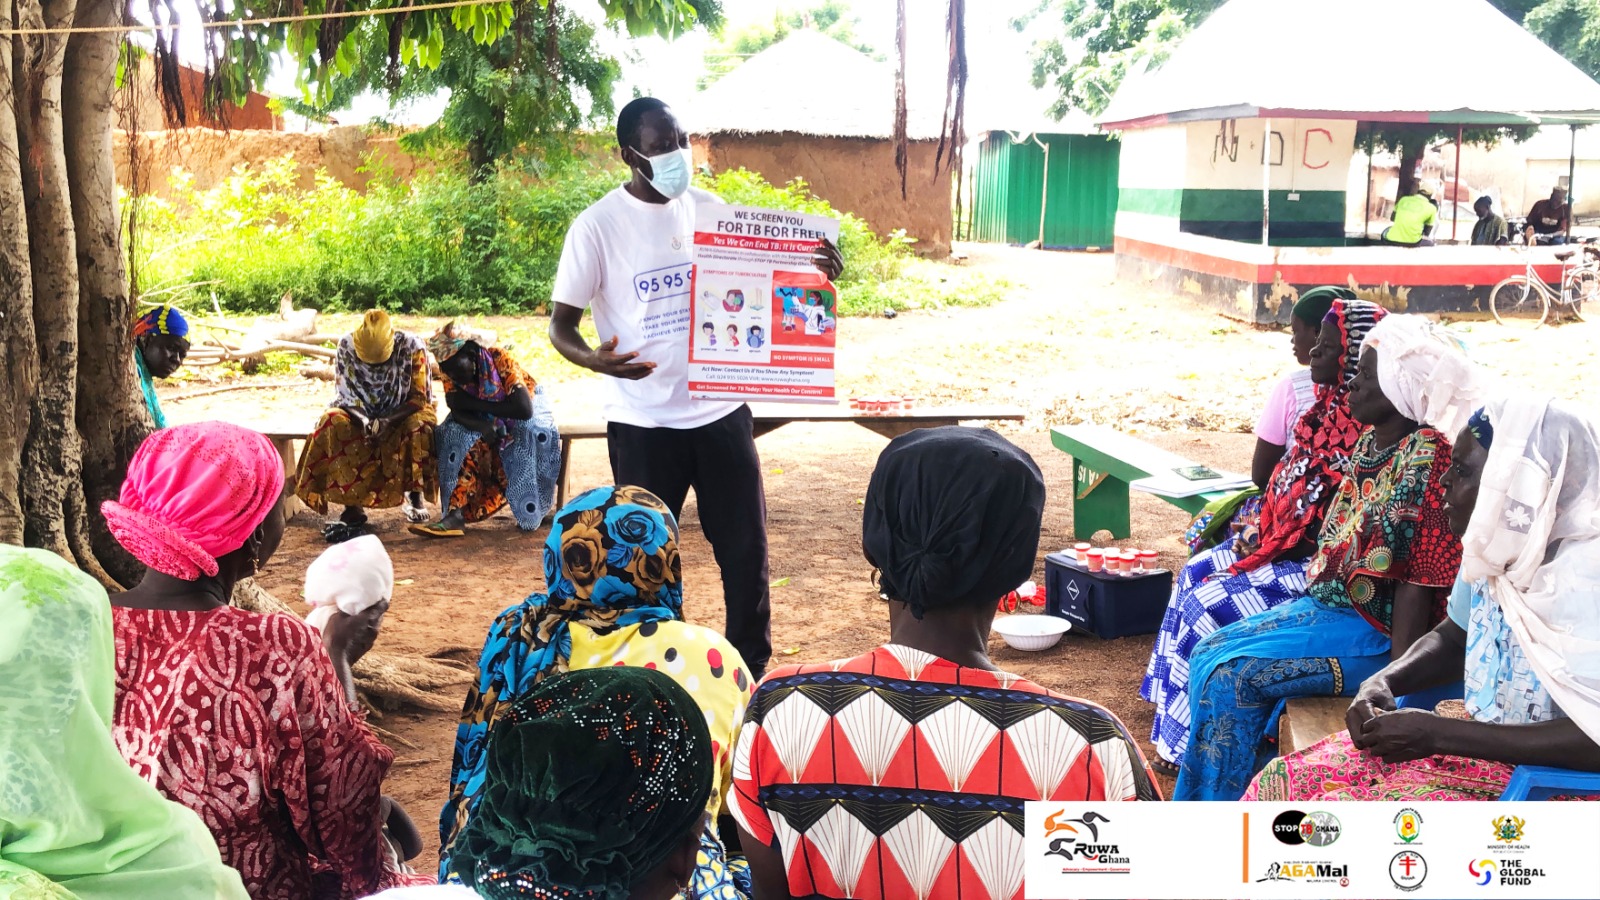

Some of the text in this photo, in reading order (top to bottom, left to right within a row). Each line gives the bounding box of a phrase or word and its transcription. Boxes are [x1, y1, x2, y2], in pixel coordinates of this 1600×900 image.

[734, 210, 803, 227] WE SCREEN YOU
[717, 220, 826, 240] FOR TB FOR FREE!
[713, 236, 726, 246] Yes
[727, 236, 739, 247] We
[739, 238, 754, 248] Can
[755, 240, 769, 251] End
[770, 241, 782, 251] TB:
[639, 277, 660, 294] 95
[663, 272, 684, 290] 95
[643, 314, 661, 322] KNOW
[662, 310, 678, 318] YOUR
